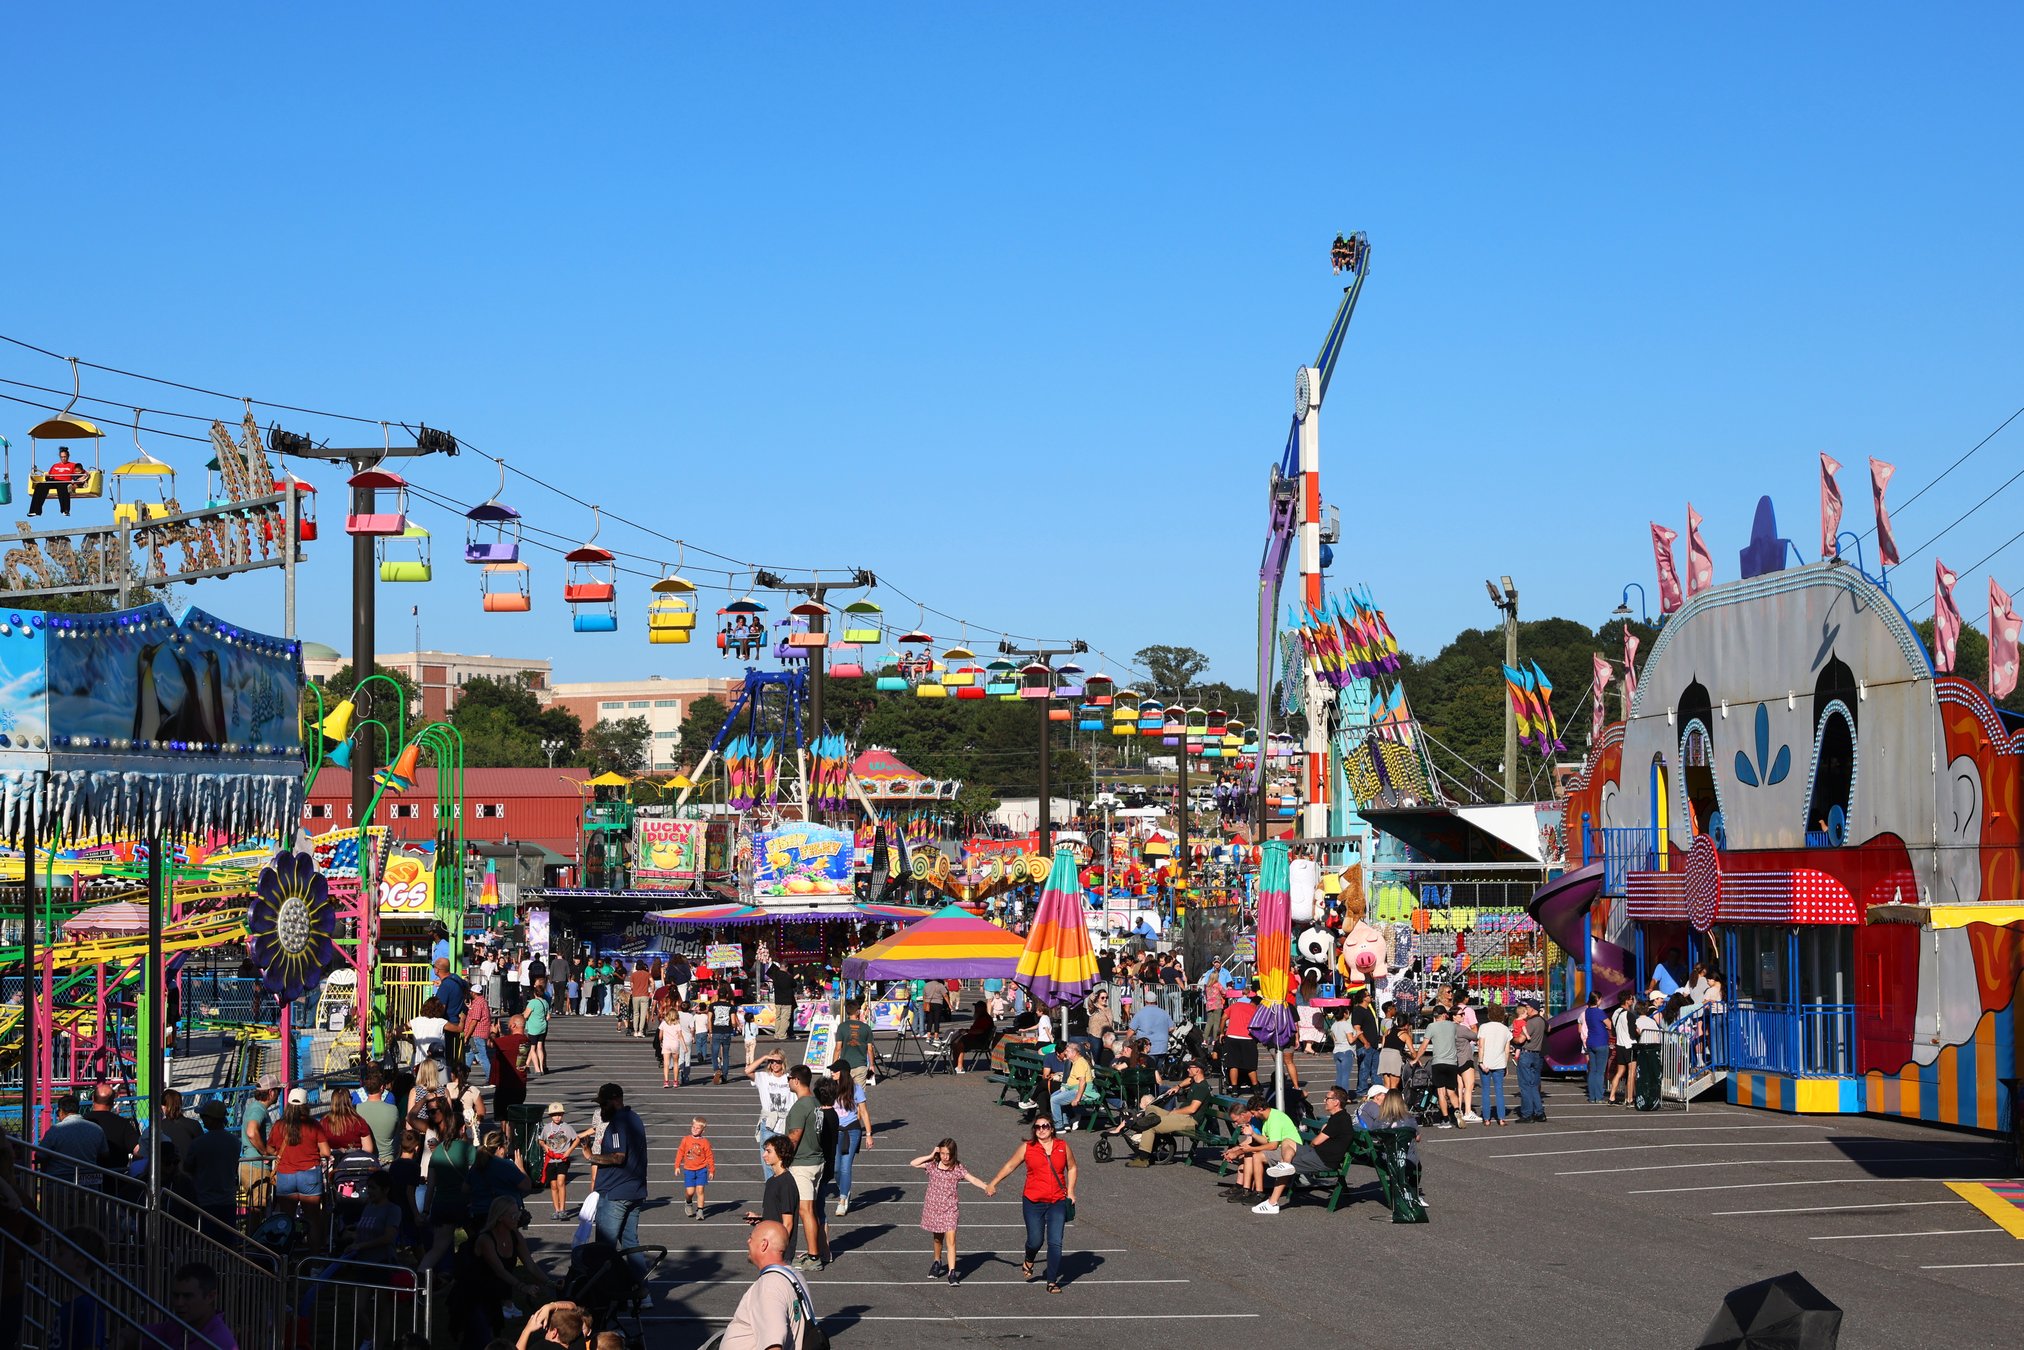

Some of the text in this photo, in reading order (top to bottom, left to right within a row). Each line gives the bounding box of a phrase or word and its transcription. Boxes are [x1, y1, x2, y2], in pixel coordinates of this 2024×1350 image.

[643, 822, 694, 833] LUCKY
[647, 832, 689, 844] DUCK
[1120, 986, 1131, 996] 71
